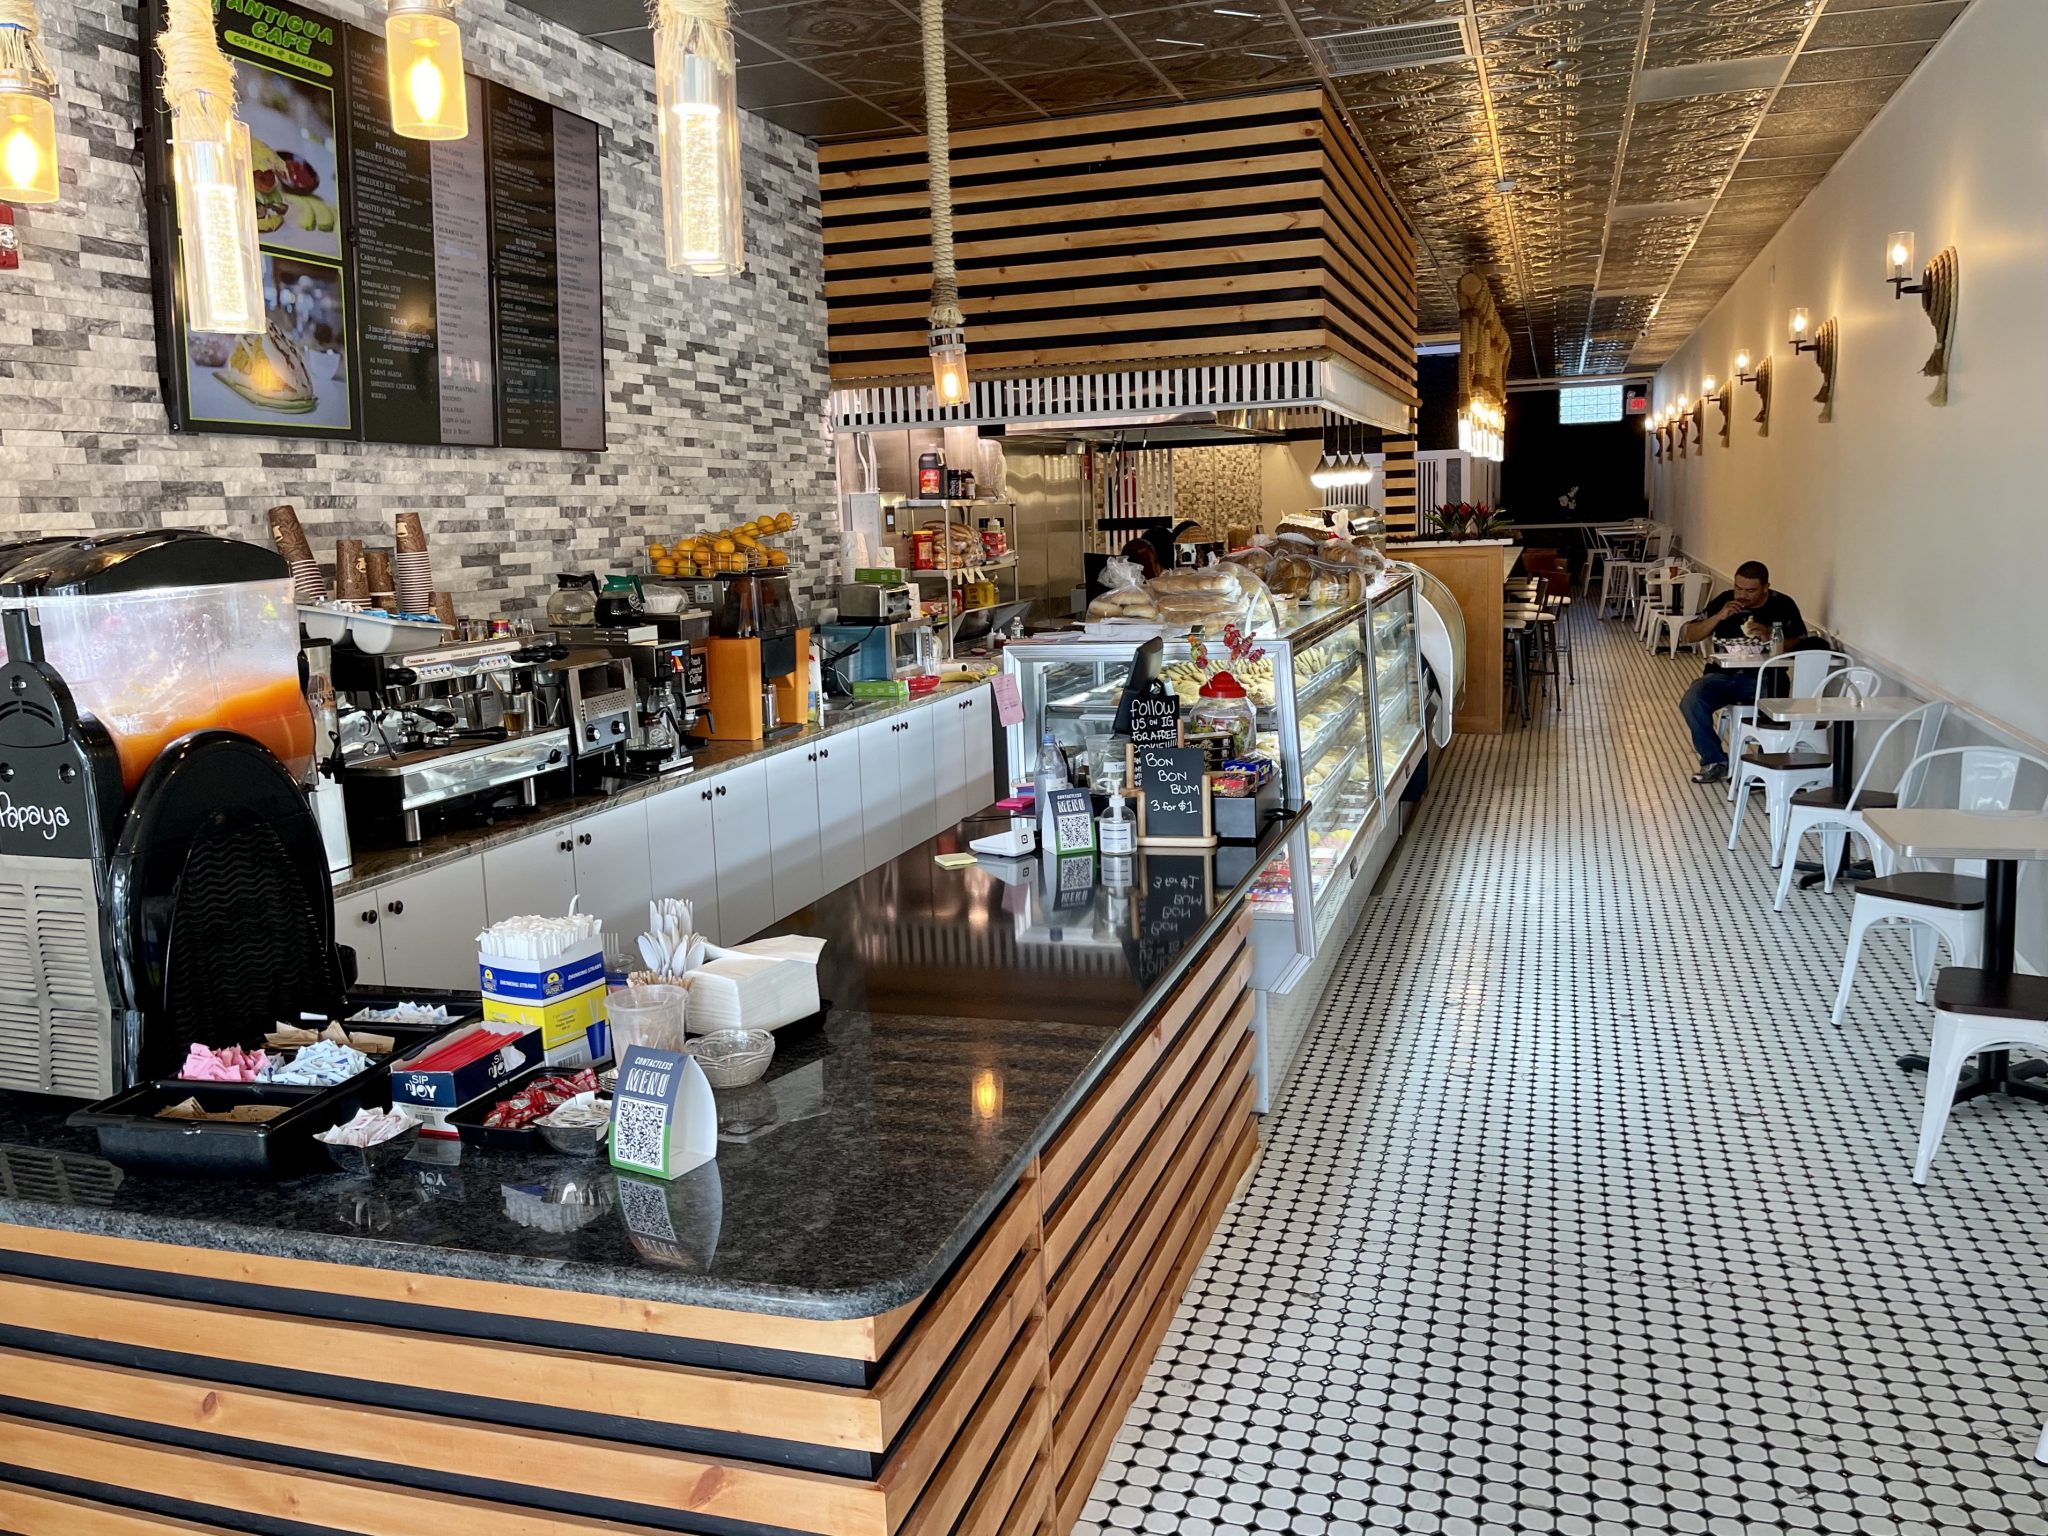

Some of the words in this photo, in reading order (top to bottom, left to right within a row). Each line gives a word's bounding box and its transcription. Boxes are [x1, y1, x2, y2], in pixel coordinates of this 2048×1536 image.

[226, 0, 333, 46] ANTIGUA
[252, 22, 312, 54] CAFE
[233, 35, 274, 54] COFFEE
[288, 53, 324, 72] BAKERY
[376, 142, 407, 158] PATACONES
[1132, 718, 1146, 730] US
[1162, 716, 1174, 727] IG
[1132, 730, 1150, 742] FOR
[1150, 731, 1158, 741] A
[1156, 729, 1177, 740] FREE
[1158, 770, 1188, 782] BON
[1170, 784, 1200, 796] BUM
[1057, 798, 1086, 812] MENU
[1150, 800, 1160, 812] 3
[1162, 801, 1176, 812] for
[1178, 800, 1198, 814] $1
[0, 791, 70, 840] Papaya
[634, 1056, 674, 1071] CONTACTLESS
[412, 1074, 429, 1085] SIP
[625, 1068, 670, 1098] MENU
